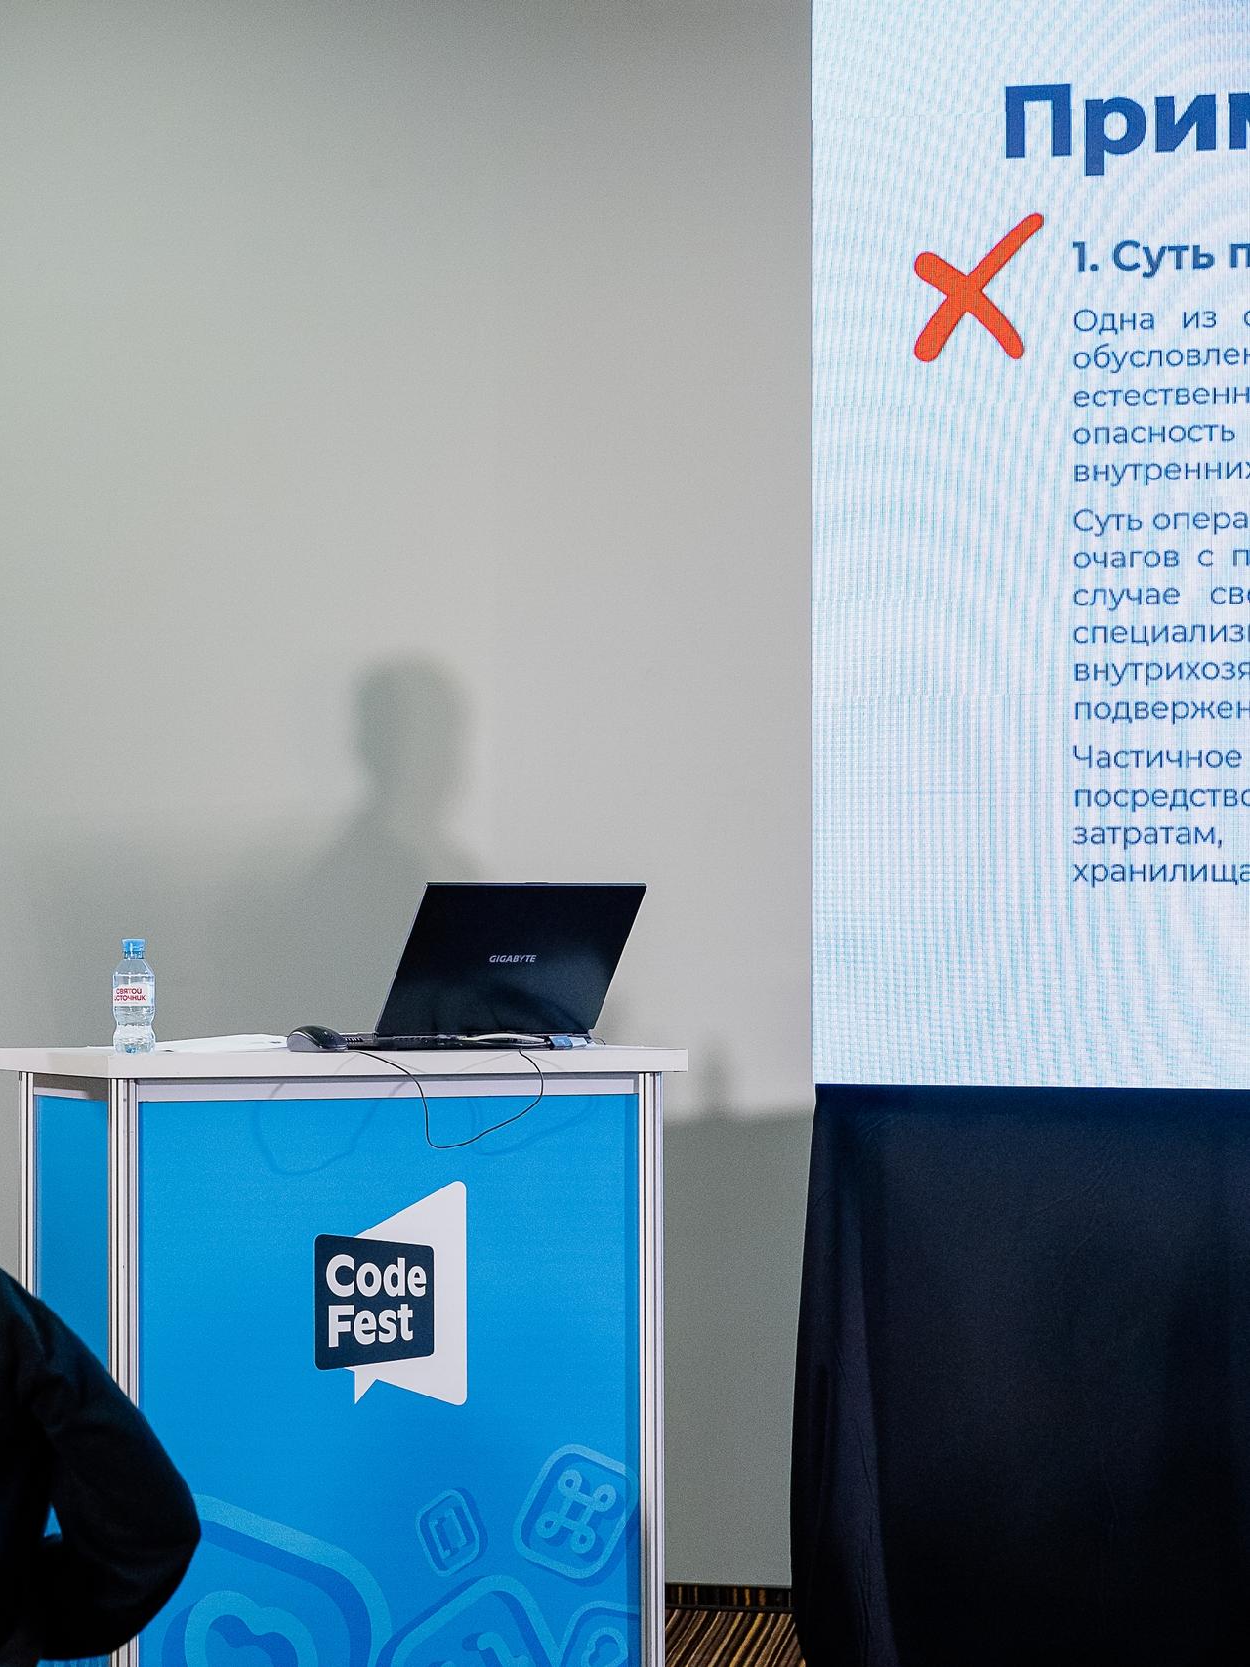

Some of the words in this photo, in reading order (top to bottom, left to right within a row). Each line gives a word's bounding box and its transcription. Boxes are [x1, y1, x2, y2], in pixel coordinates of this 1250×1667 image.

[1005, 83, 1250, 176] При
[1073, 241, 1099, 272] 1.
[1112, 239, 1215, 278] Суть
[1073, 309, 1155, 335] Одна
[1183, 311, 1217, 329] из
[1073, 386, 1250, 408] естественн
[1073, 424, 1235, 445] опасность
[1073, 509, 1143, 536] Суть
[1152, 512, 1249, 535] опера
[1073, 549, 1180, 569] очагов
[1197, 549, 1213, 567] с
[1073, 586, 1180, 611] случае
[1210, 587, 1250, 605] св
[1073, 624, 1250, 646] специализ
[1075, 661, 1250, 686] внутрихозя
[1073, 745, 1242, 768] Частичное
[1073, 826, 1223, 849] затратам,
[488, 954, 537, 964] GIGABYTE
[325, 1253, 427, 1298] Code
[328, 1303, 414, 1348] Fest
